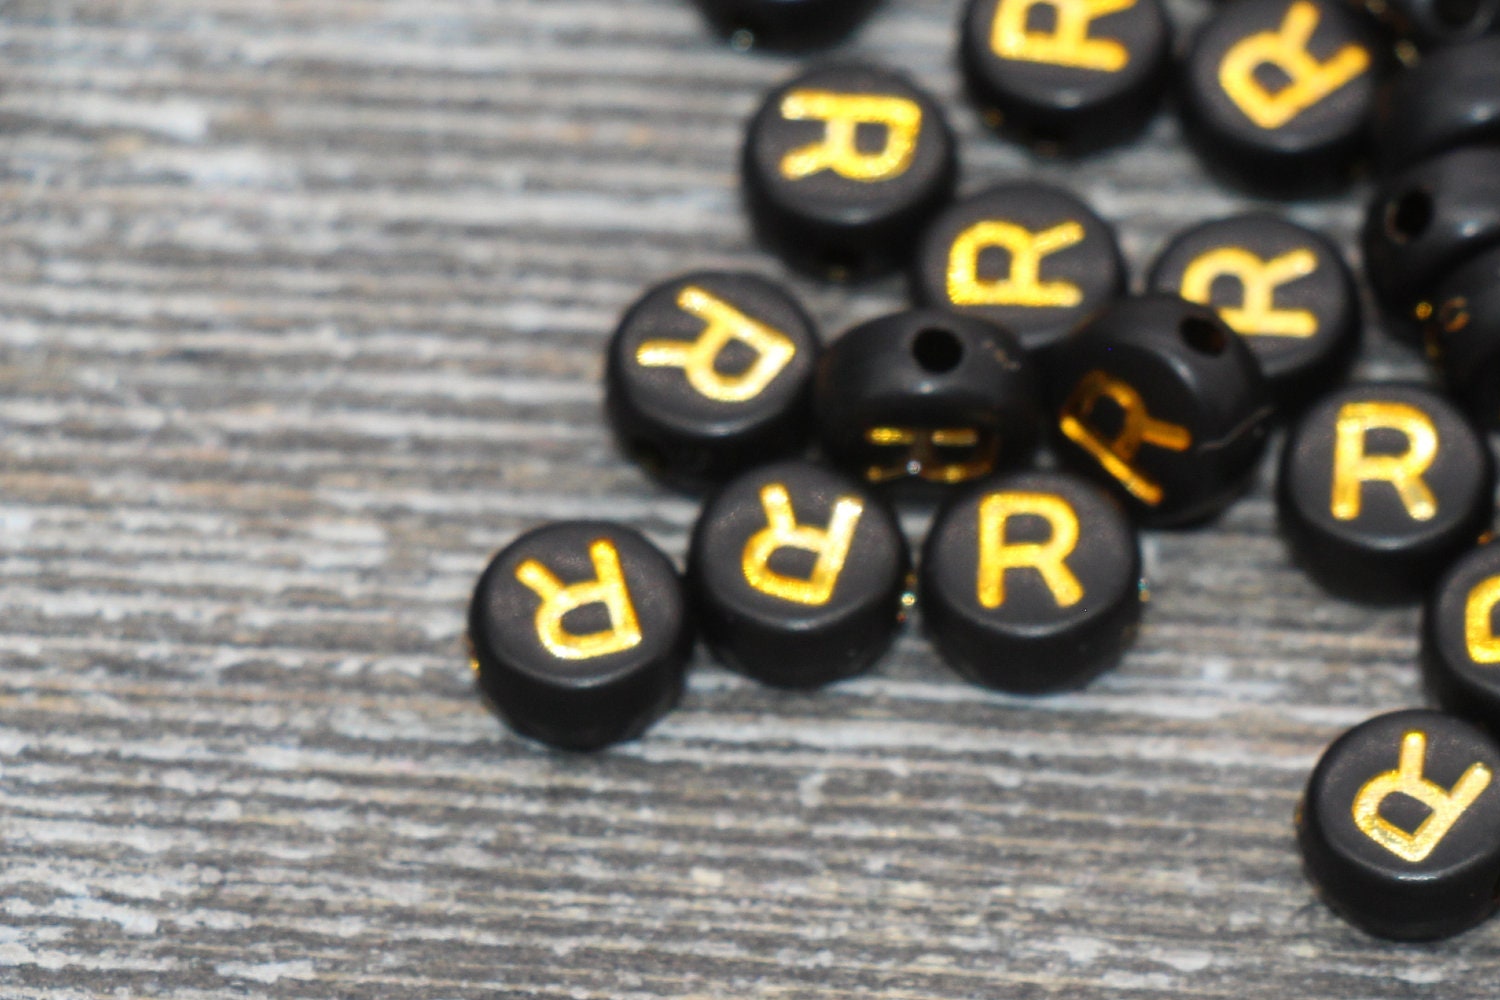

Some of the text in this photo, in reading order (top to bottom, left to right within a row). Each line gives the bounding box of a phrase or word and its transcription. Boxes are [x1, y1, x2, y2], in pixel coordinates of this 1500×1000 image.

[990, 0, 1137, 72] R
[1218, 0, 1369, 129] R
[780, 90, 923, 181] R
[946, 220, 1084, 308] R
[1180, 246, 1318, 337] R
[636, 286, 797, 401] R
[1331, 401, 1440, 521] R
[516, 540, 643, 659] R
[742, 484, 863, 607] R
[976, 491, 1084, 609] R
[1352, 731, 1492, 860] R
